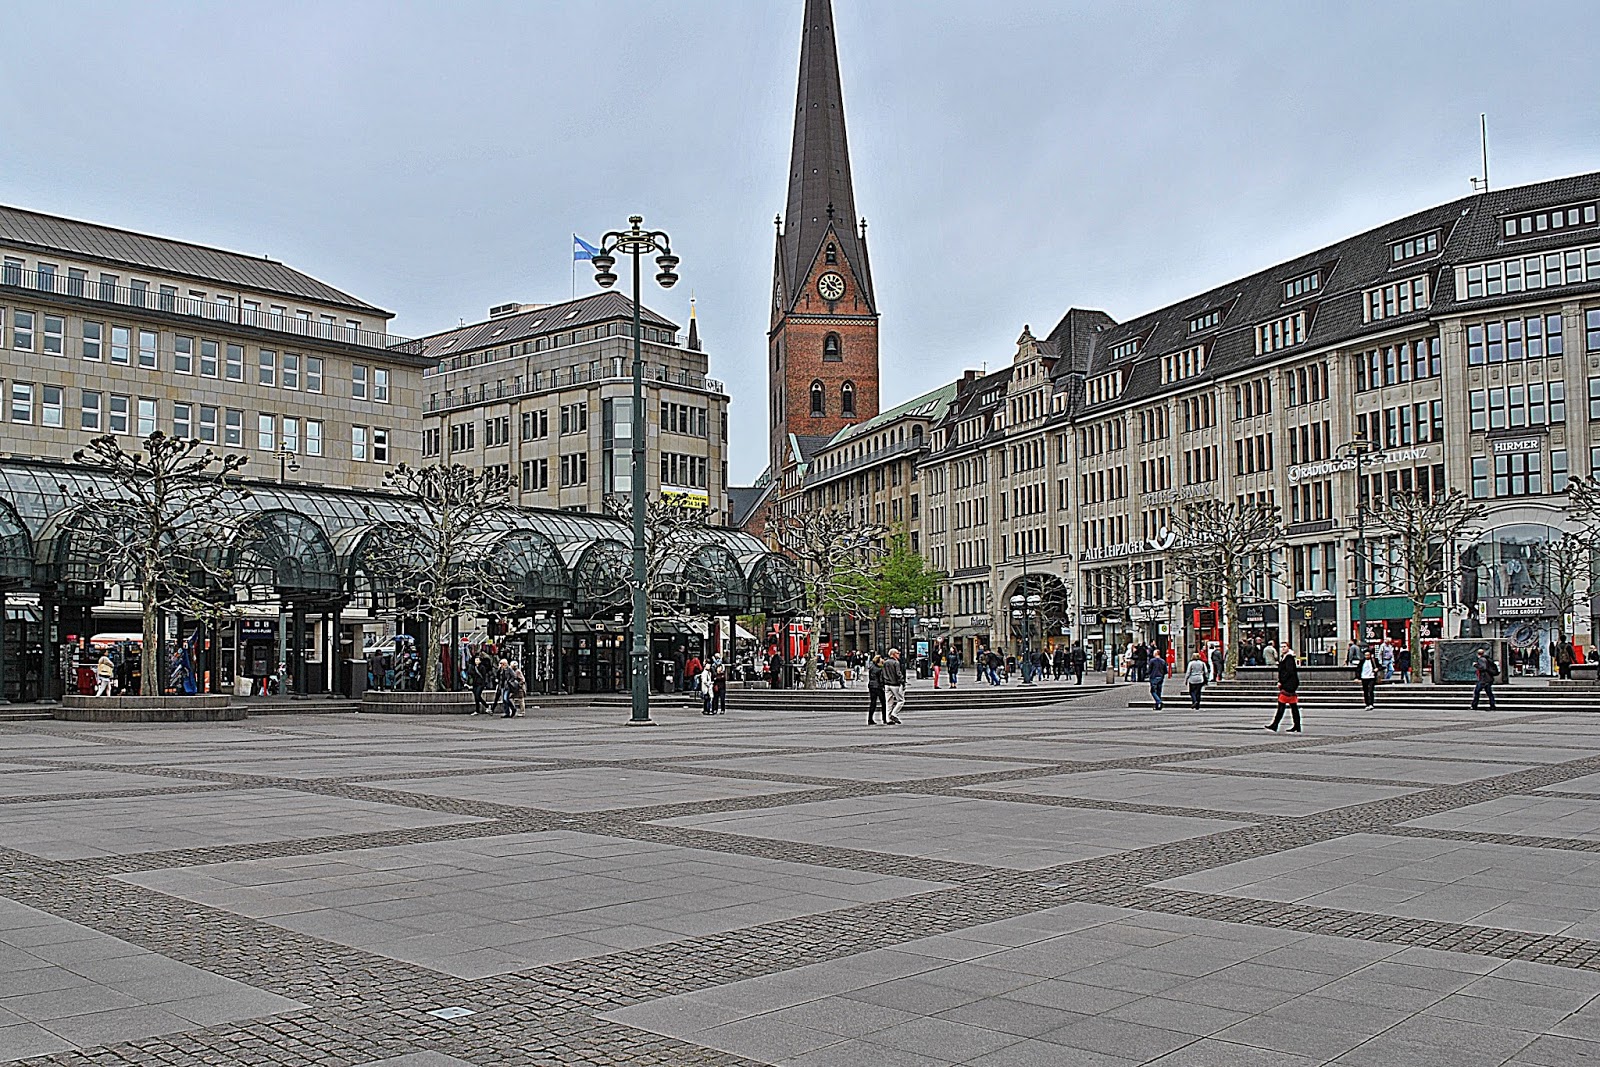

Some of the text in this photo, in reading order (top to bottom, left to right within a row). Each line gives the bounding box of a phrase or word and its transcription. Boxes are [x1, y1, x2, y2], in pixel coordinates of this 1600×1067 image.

[1494, 440, 1538, 452] HIRMER
[1300, 454, 1376, 478] RADIOLOGIS
[1084, 546, 1103, 560] ALTE
[1104, 540, 1145, 559] LEIPZIGER
[1499, 597, 1543, 607] HIRMER
